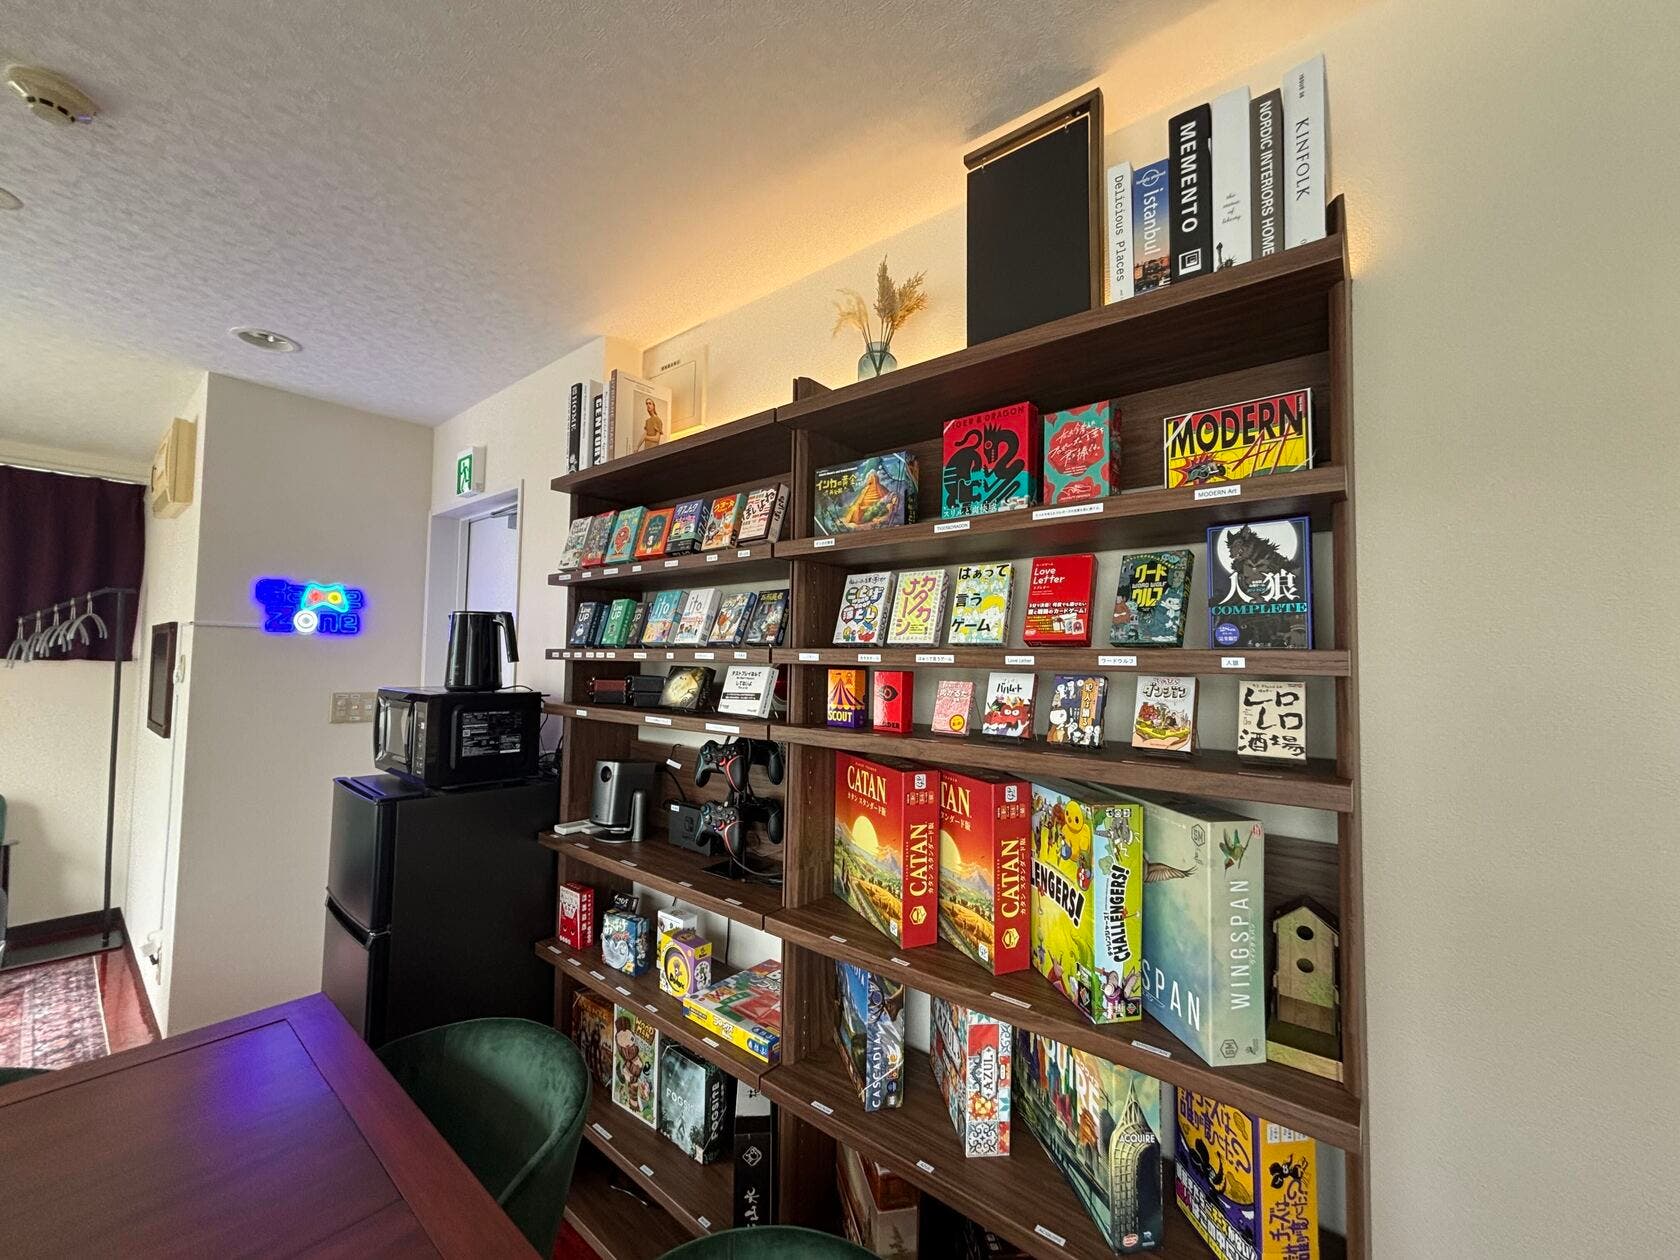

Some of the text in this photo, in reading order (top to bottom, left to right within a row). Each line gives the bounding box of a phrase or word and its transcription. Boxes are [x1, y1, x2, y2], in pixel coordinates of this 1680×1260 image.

[1259, 101, 1273, 151] NORDIC
[1296, 117, 1310, 201] KINFOLK
[1180, 121, 1198, 233] MEMENTO
[1260, 152, 1274, 218] INTERIORS
[1114, 174, 1125, 282] Delicious Places
[1143, 187, 1164, 256] istanbul
[984, 406, 1024, 422] DRAGON
[1169, 395, 1302, 459] MODERN
[1232, 422, 1296, 478] Art
[1198, 487, 1238, 498] MODERN Art
[958, 564, 1010, 580] はぁって
[1033, 576, 1066, 585] Letter
[1034, 568, 1056, 576] Love
[1135, 563, 1168, 583] ワード
[1132, 587, 1163, 607] ウルフ
[1219, 569, 1300, 605] 人狼
[655, 598, 670, 617] ito
[689, 597, 703, 613] ito
[956, 593, 983, 607] 言う
[1212, 602, 1308, 616] COMPLETE
[951, 619, 991, 633] ゲーム
[1143, 682, 1187, 699] ダンジョン
[828, 710, 853, 723] SCOUT
[1238, 729, 1305, 757] 酒場
[848, 765, 887, 805] CATAN
[909, 824, 928, 897] CATAN
[1001, 840, 1019, 918] CATAN
[1110, 863, 1131, 963] CHALLENGERS!
[1230, 880, 1250, 1010] WINGSPAN
[635, 1017, 654, 1035] WOOD
[636, 1025, 650, 1039] MAN
[983, 1054, 994, 1091] AZUL
[711, 1081, 720, 1140] FOGSITE
[1119, 1133, 1156, 1144] ACQUIRE
